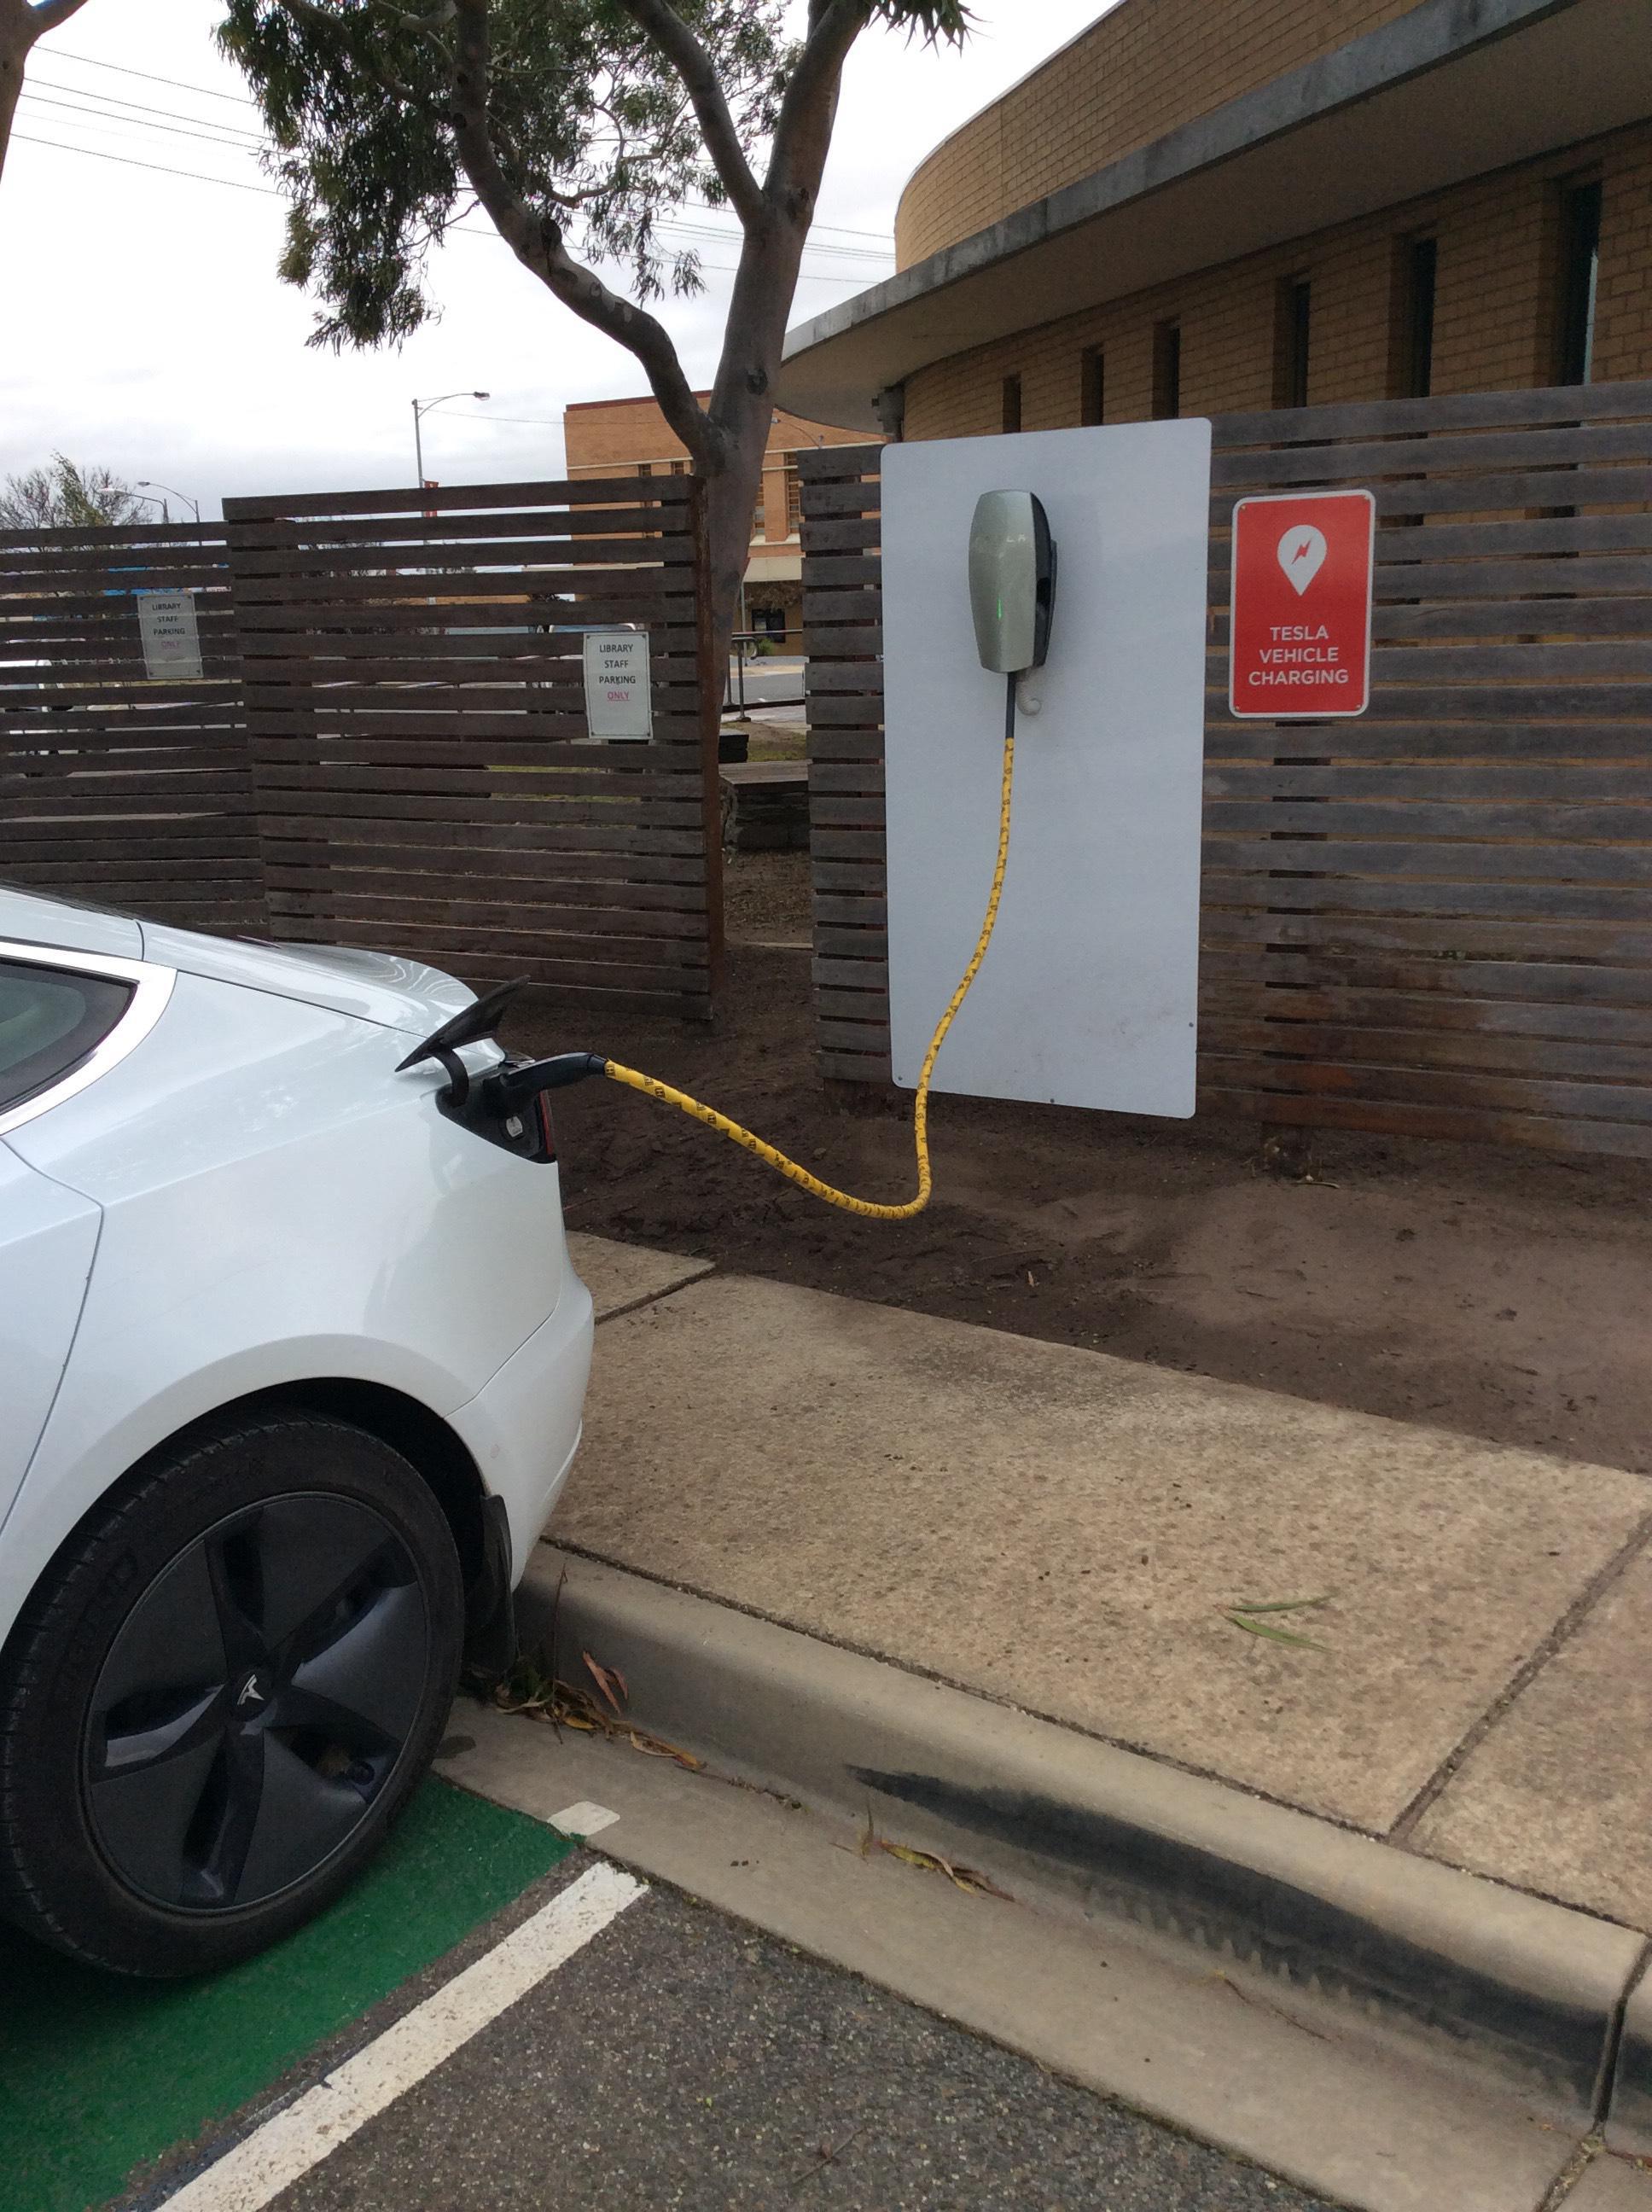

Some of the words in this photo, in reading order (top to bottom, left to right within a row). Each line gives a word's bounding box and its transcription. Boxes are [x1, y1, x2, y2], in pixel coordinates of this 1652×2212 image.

[1270, 625, 1329, 641] TESLA
[599, 644, 633, 653] LIBRARY
[1259, 647, 1339, 664] VEHICLE
[604, 660, 629, 668] STAFF
[599, 675, 636, 684] PARKING
[1248, 668, 1348, 685] CHARGING
[607, 691, 630, 701] ONLY
